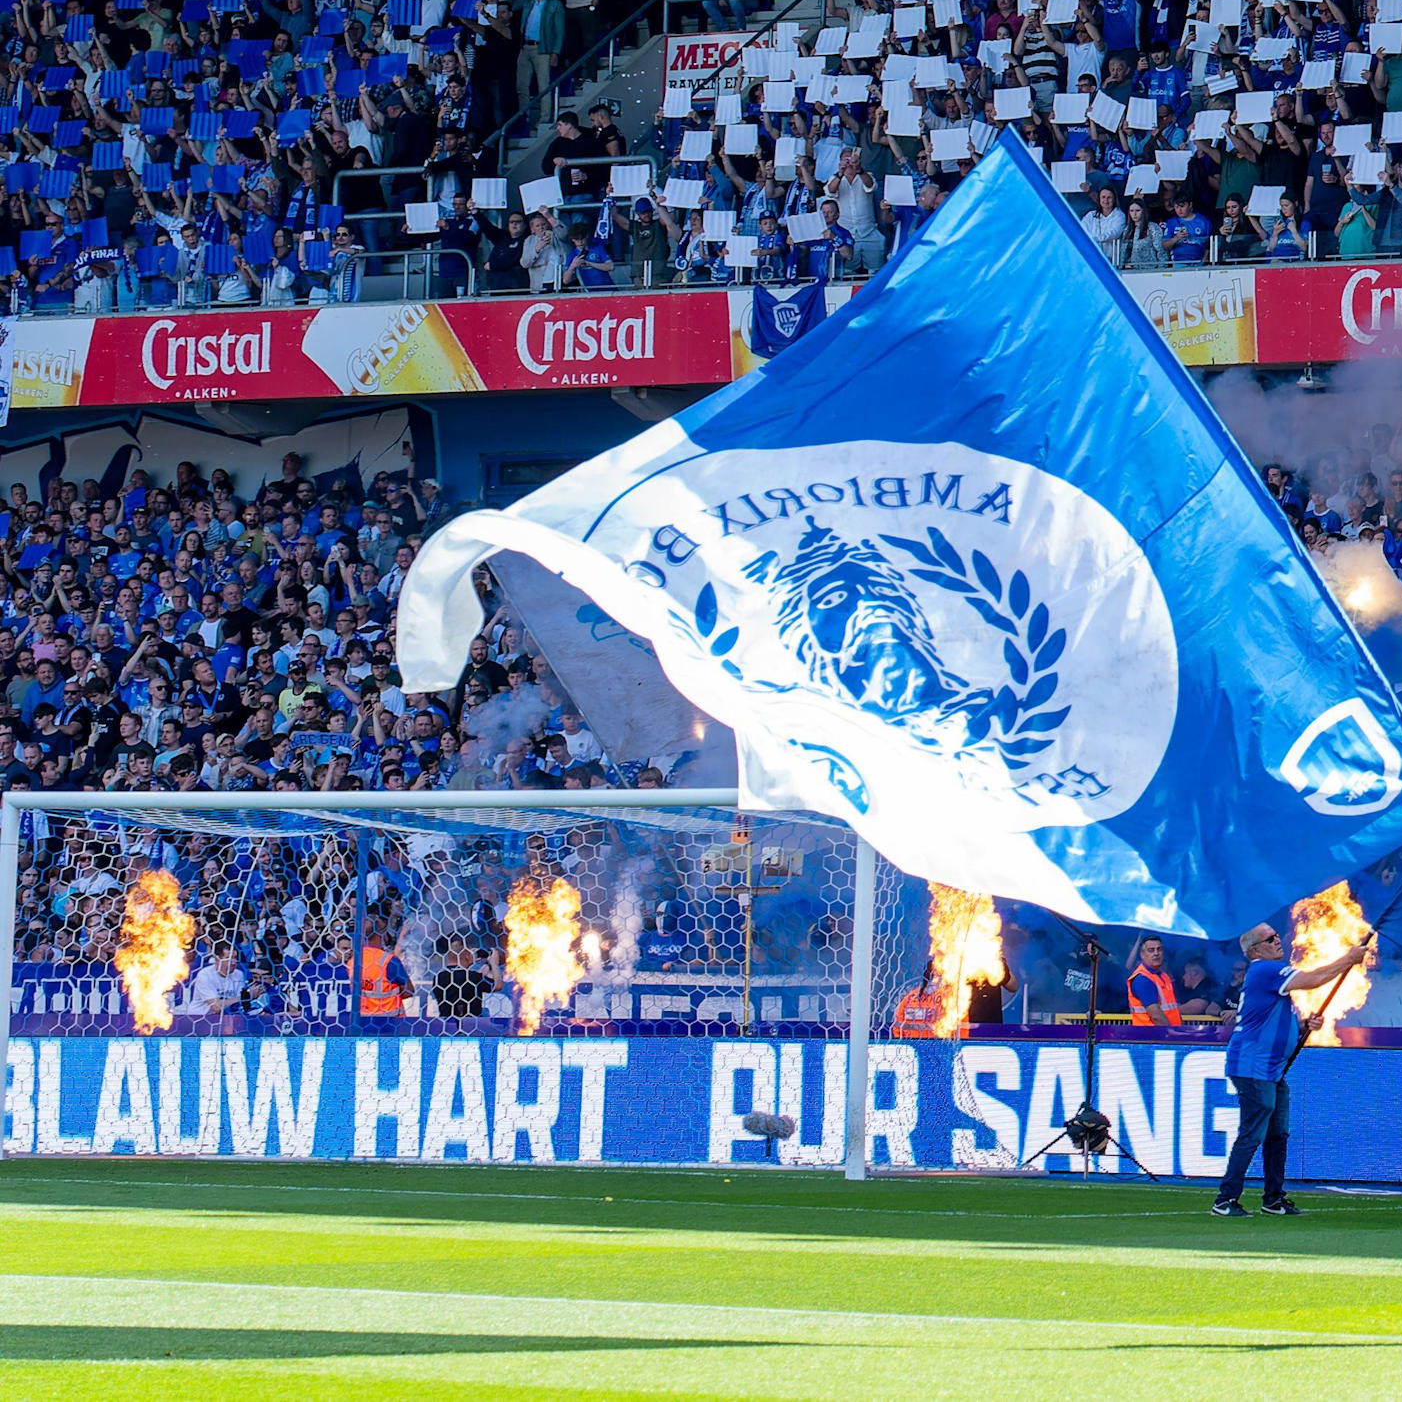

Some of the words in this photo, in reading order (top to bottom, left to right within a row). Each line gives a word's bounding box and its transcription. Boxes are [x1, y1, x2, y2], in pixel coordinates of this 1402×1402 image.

[91, 248, 119, 259] FINAL
[1144, 277, 1245, 336] Cristal
[142, 318, 272, 390] Cristal
[345, 303, 428, 394] Cristal
[516, 302, 654, 375] Cristal
[1177, 333, 1214, 349] ALKEN
[184, 387, 227, 399] ALKEN
[561, 372, 608, 385] ALKEN
[3, 1038, 326, 1156] BLAUW
[354, 1039, 628, 1162] HART
[709, 1042, 918, 1168] PUR
